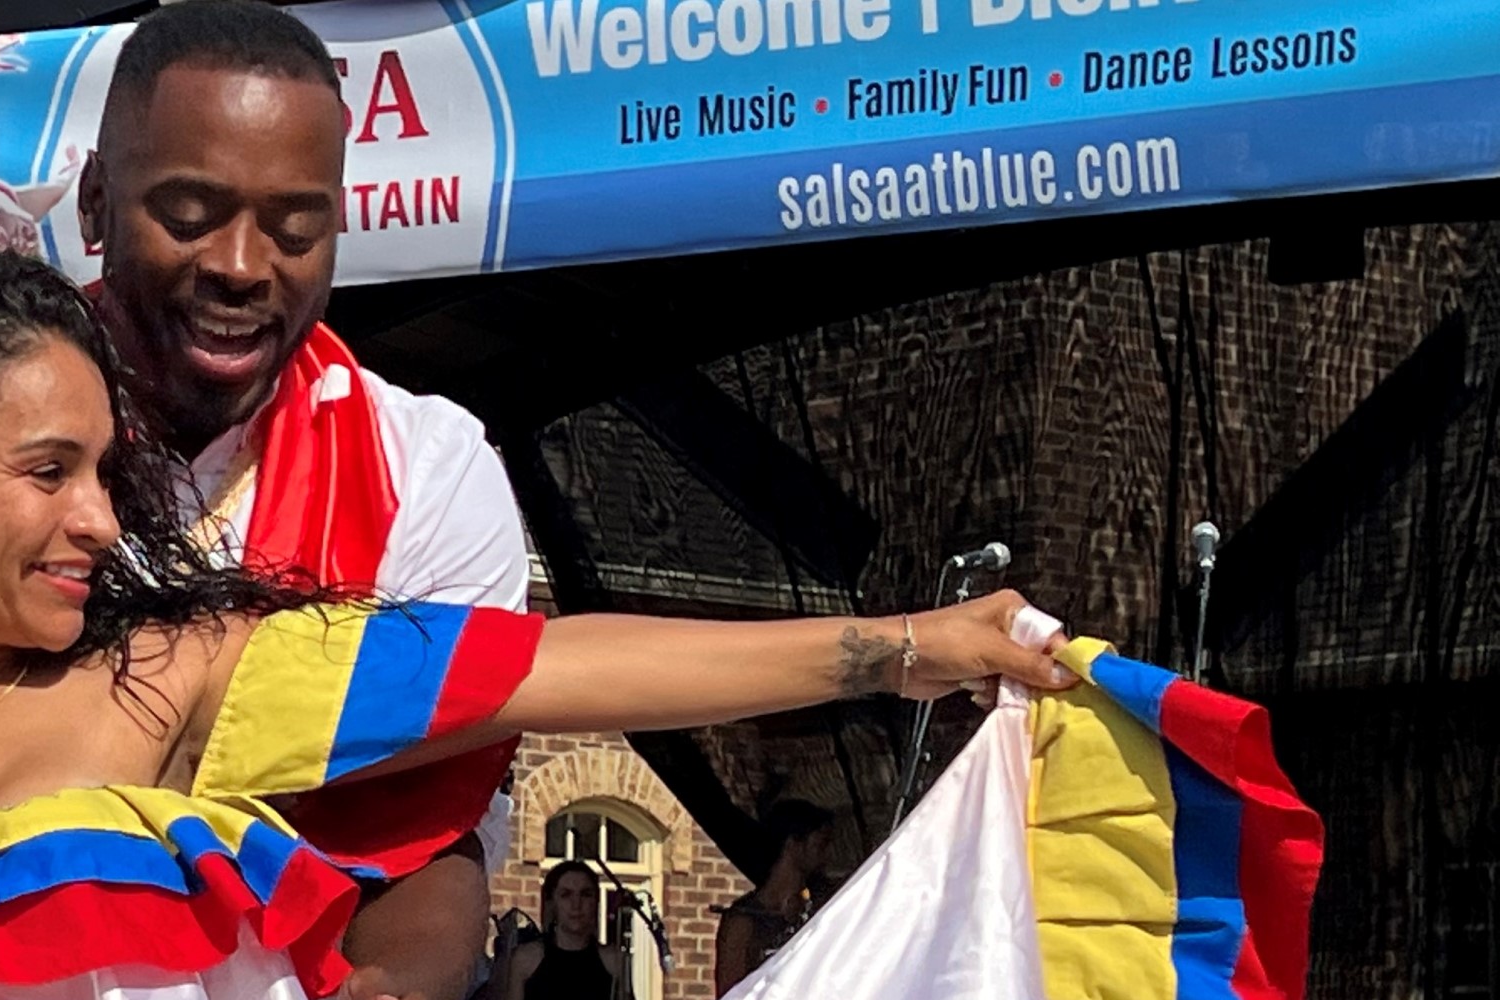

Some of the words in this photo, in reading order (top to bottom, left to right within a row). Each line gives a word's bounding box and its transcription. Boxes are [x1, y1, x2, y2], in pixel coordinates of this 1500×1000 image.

[526, 0, 890, 77] Welcome
[621, 100, 681, 144] Live
[699, 86, 796, 137] Music
[848, 69, 958, 120] Family
[968, 65, 1027, 106] Fun
[1084, 47, 1192, 93] Dance
[1211, 27, 1356, 78] Lessons
[778, 136, 1180, 230] salsaatblue.com
